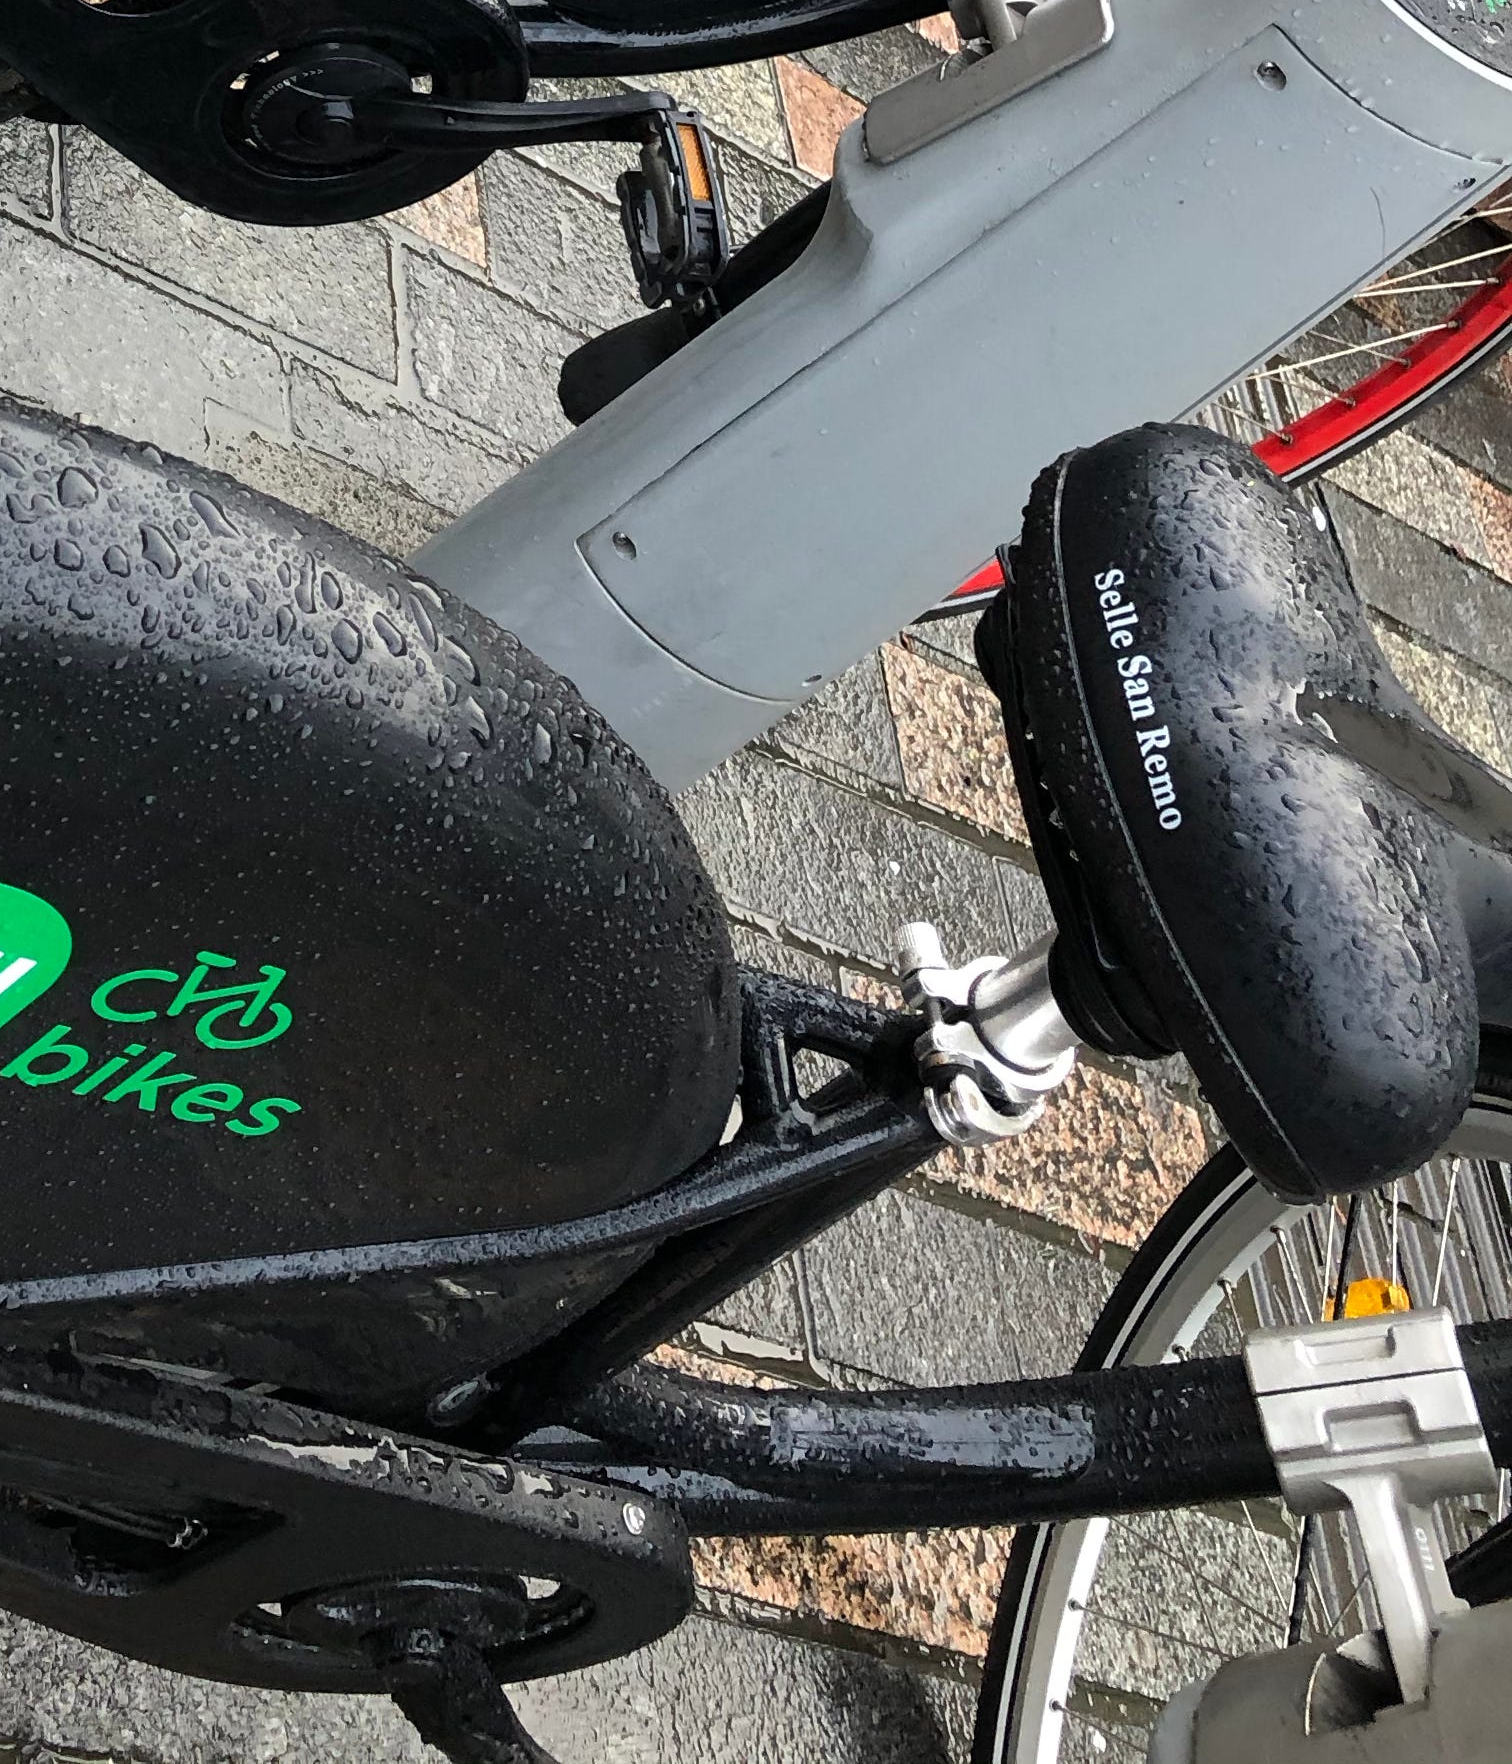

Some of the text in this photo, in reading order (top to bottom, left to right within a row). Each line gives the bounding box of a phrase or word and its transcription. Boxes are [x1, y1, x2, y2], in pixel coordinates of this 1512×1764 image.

[1093, 568, 1183, 831] Selle San Remo
